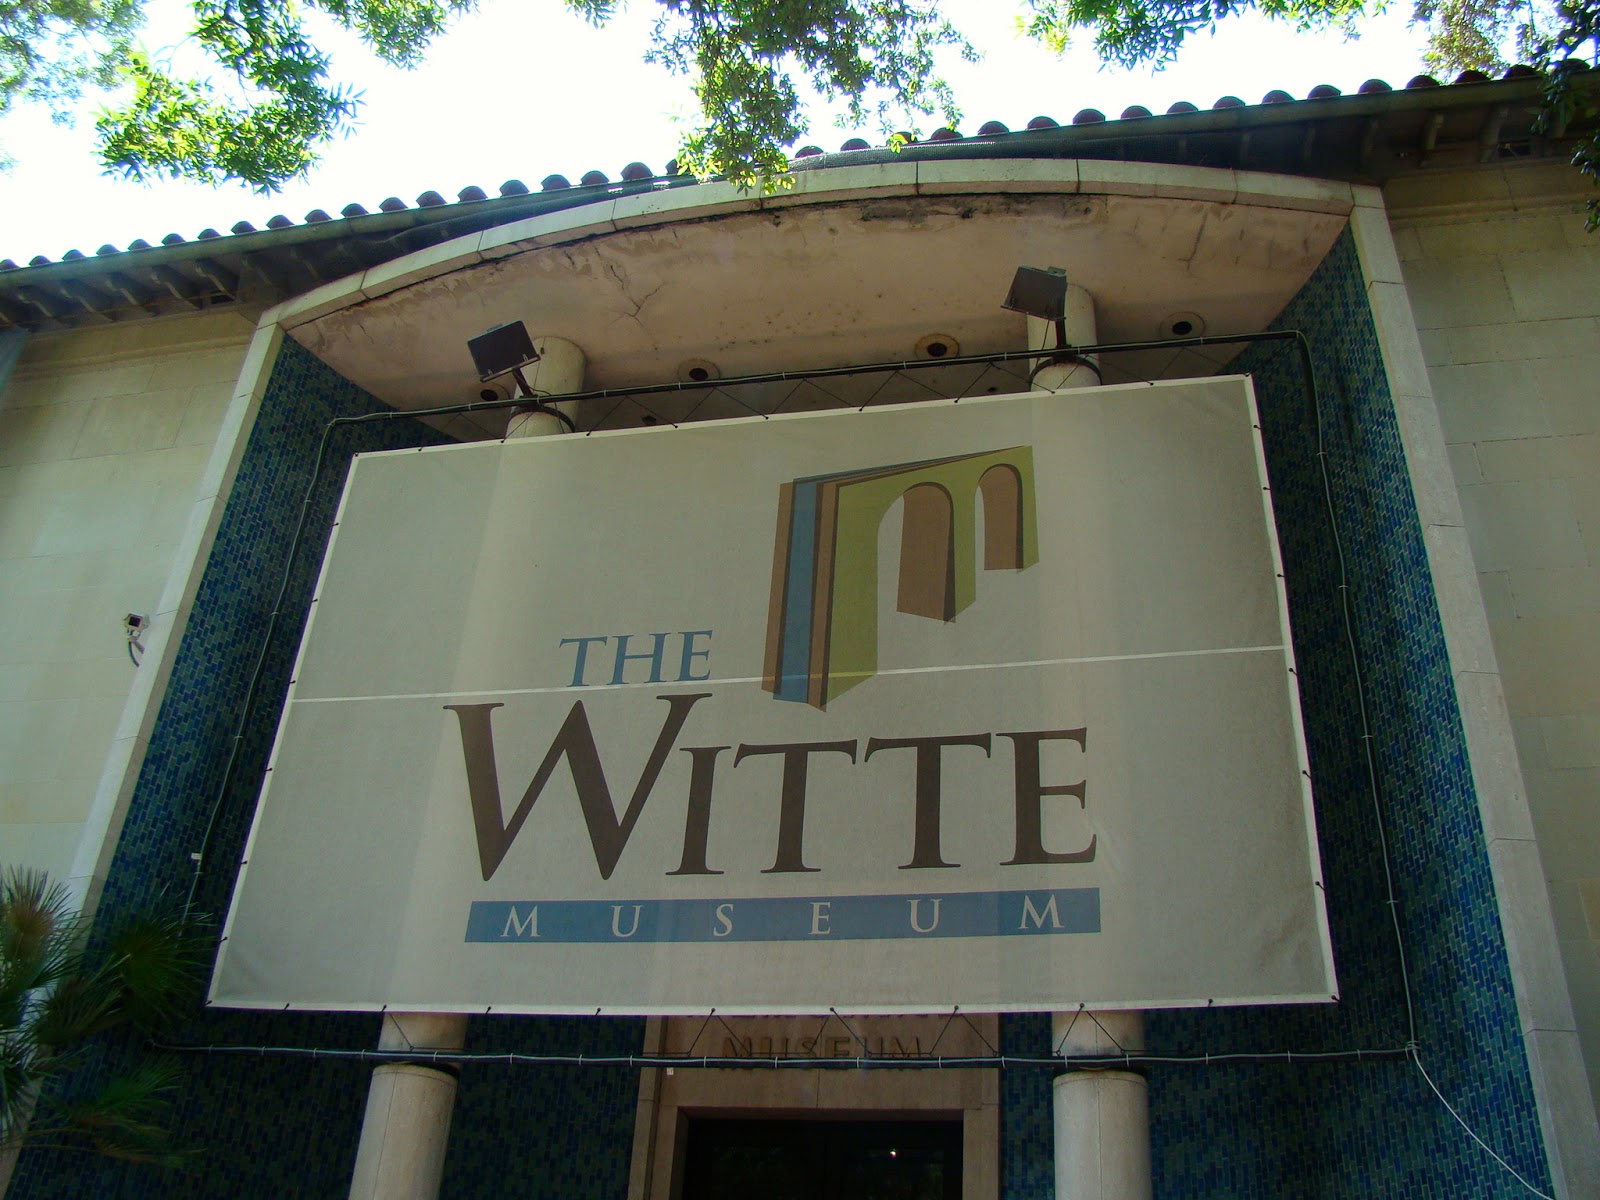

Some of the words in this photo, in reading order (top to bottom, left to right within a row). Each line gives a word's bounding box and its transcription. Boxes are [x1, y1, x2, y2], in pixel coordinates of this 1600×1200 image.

[558, 629, 713, 687] THE
[443, 692, 1097, 881] WITTE
[501, 894, 1065, 938] MUSEUM
